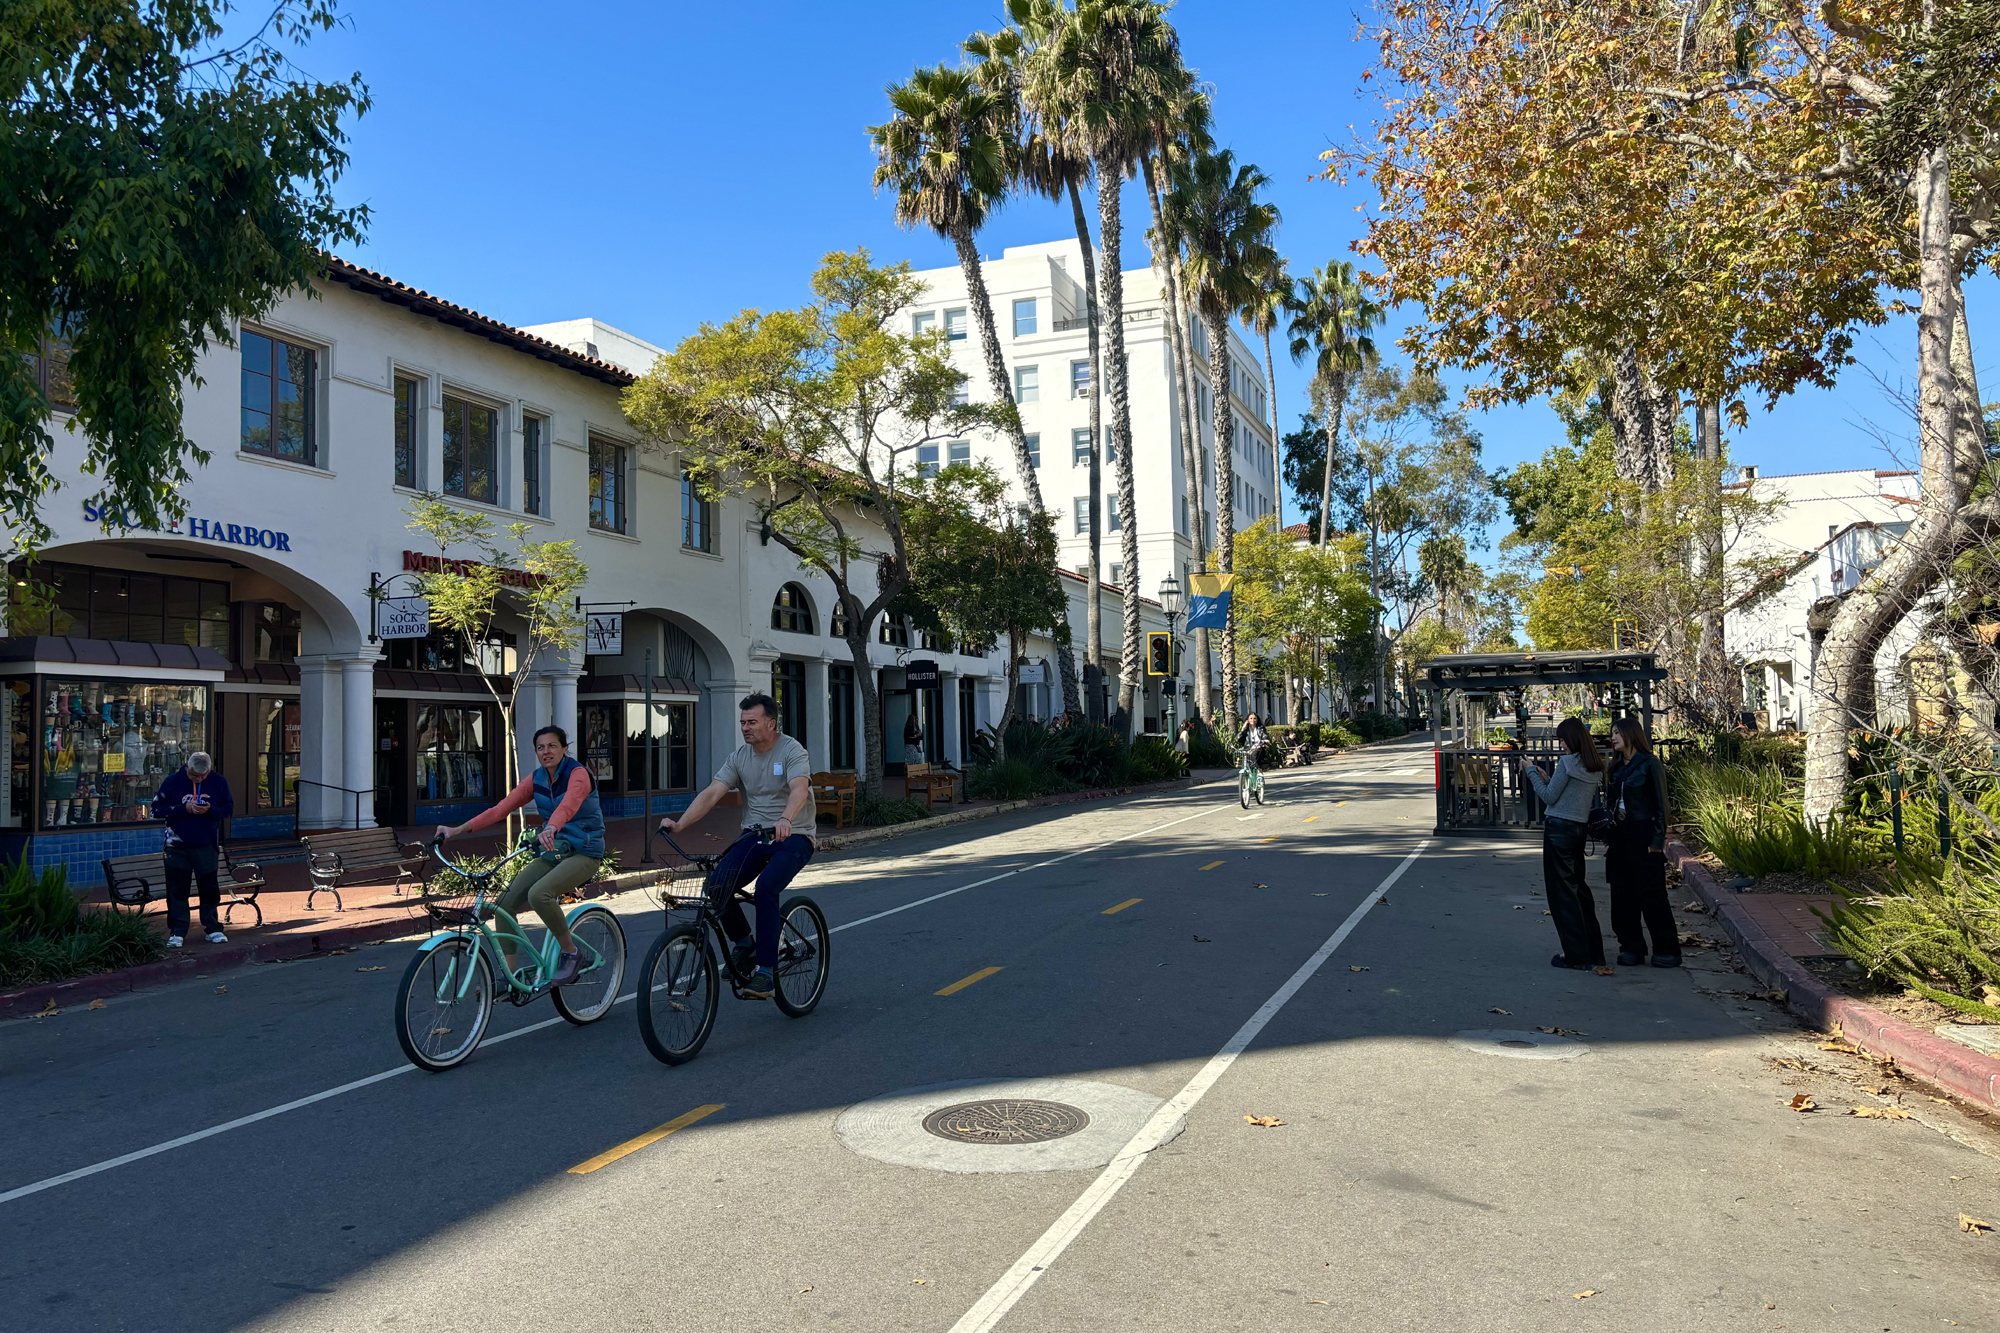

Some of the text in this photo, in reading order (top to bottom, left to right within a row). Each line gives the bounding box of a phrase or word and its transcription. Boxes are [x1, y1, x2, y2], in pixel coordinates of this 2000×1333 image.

[188, 517, 292, 552] HARBOR
[390, 613, 418, 624] SOCK
[381, 624, 427, 635] HARBOR
[908, 672, 937, 681] HOLLISTER
